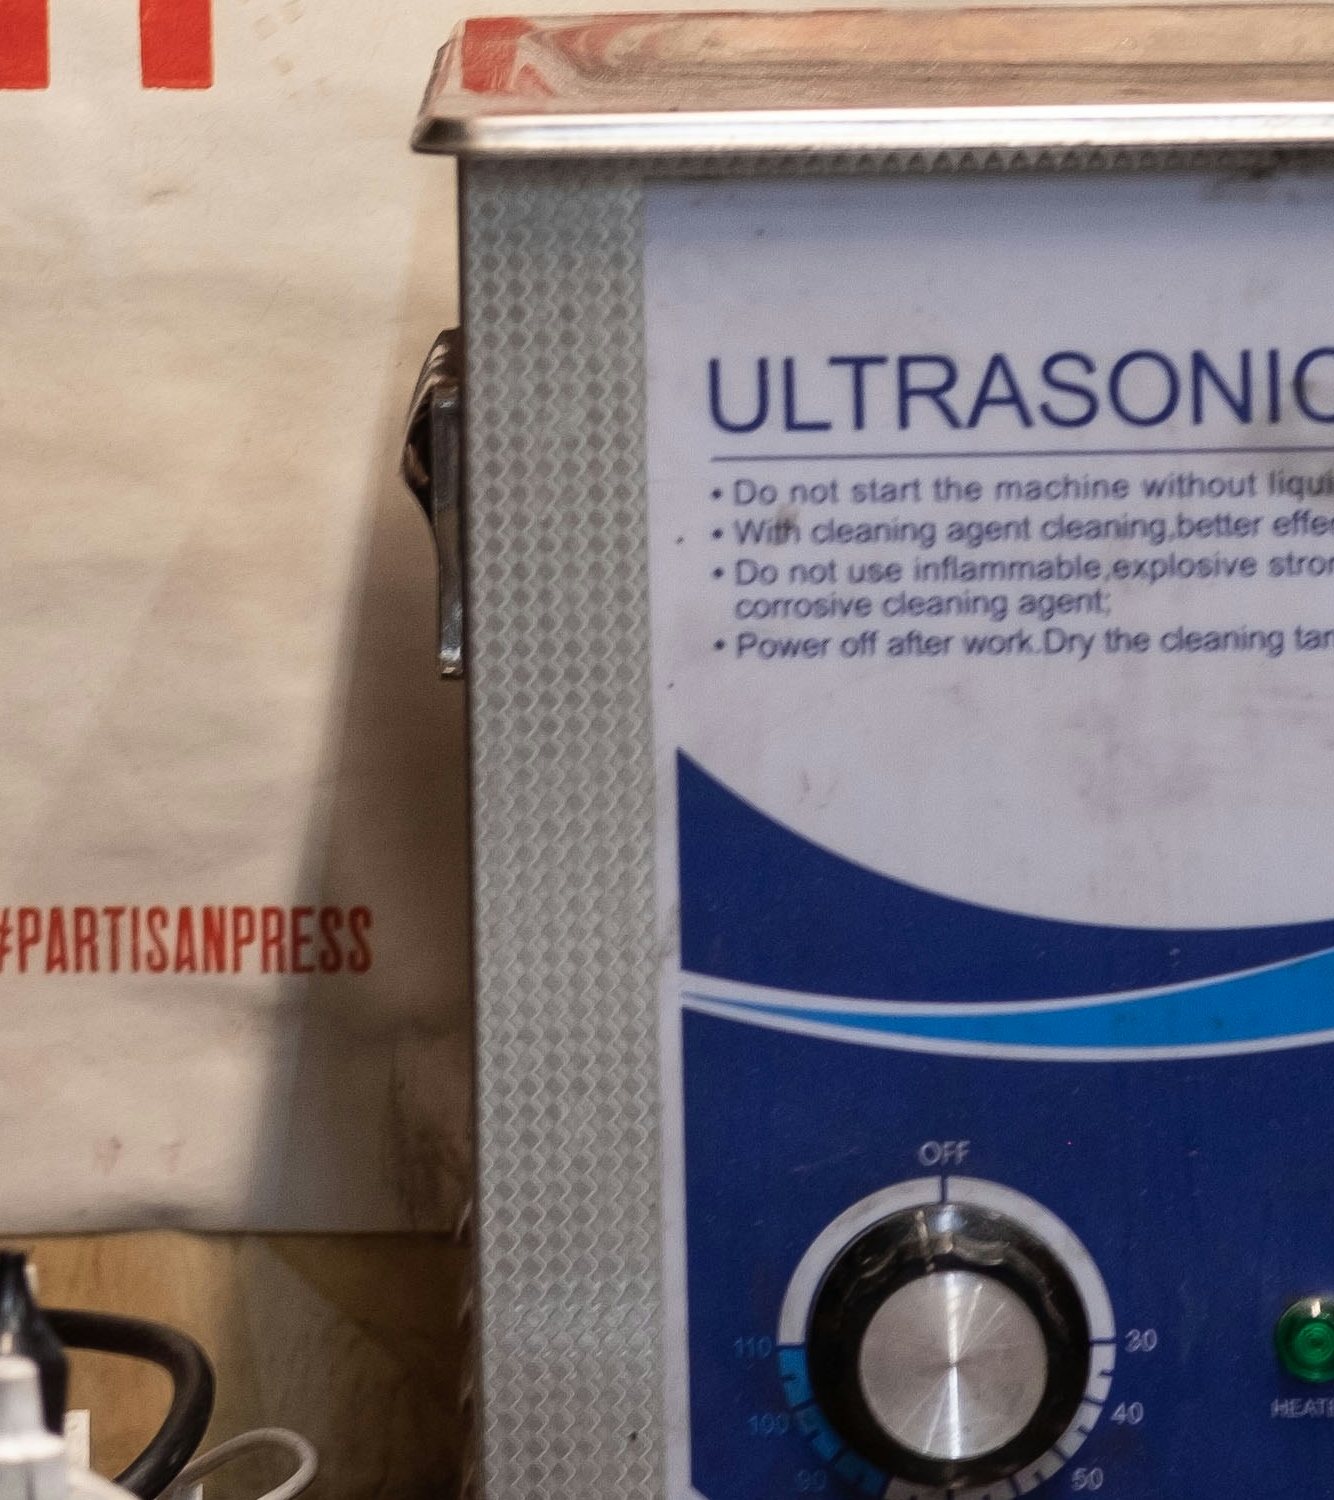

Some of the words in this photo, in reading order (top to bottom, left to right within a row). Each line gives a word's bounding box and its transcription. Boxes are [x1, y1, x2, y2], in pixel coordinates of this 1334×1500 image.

[732, 478, 779, 506] Do
[789, 478, 839, 506] not
[850, 476, 921, 504] start
[932, 475, 984, 502] the
[994, 472, 1130, 502] machine
[1141, 470, 1257, 500] without
[733, 516, 802, 546] With
[810, 514, 938, 550] cleaning
[945, 515, 1032, 550] agent
[734, 557, 779, 586] Do
[789, 558, 838, 585] not
[847, 559, 903, 585] use
[734, 592, 873, 621] corrosive
[880, 590, 1010, 623] cleaning
[1017, 588, 1112, 622] agent;
[736, 630, 832, 660] Power
[838, 629, 879, 659] off
[886, 629, 956, 658] after
[1103, 626, 1151, 654] the
[1158, 625, 1286, 659] cleaning
[916, 1140, 971, 1168] OFF
[733, 1335, 773, 1360] 110
[1124, 1329, 1158, 1353] 30
[747, 1413, 790, 1437] 100
[1110, 1401, 1145, 1425] 40
[1071, 1467, 1105, 1492] 50
